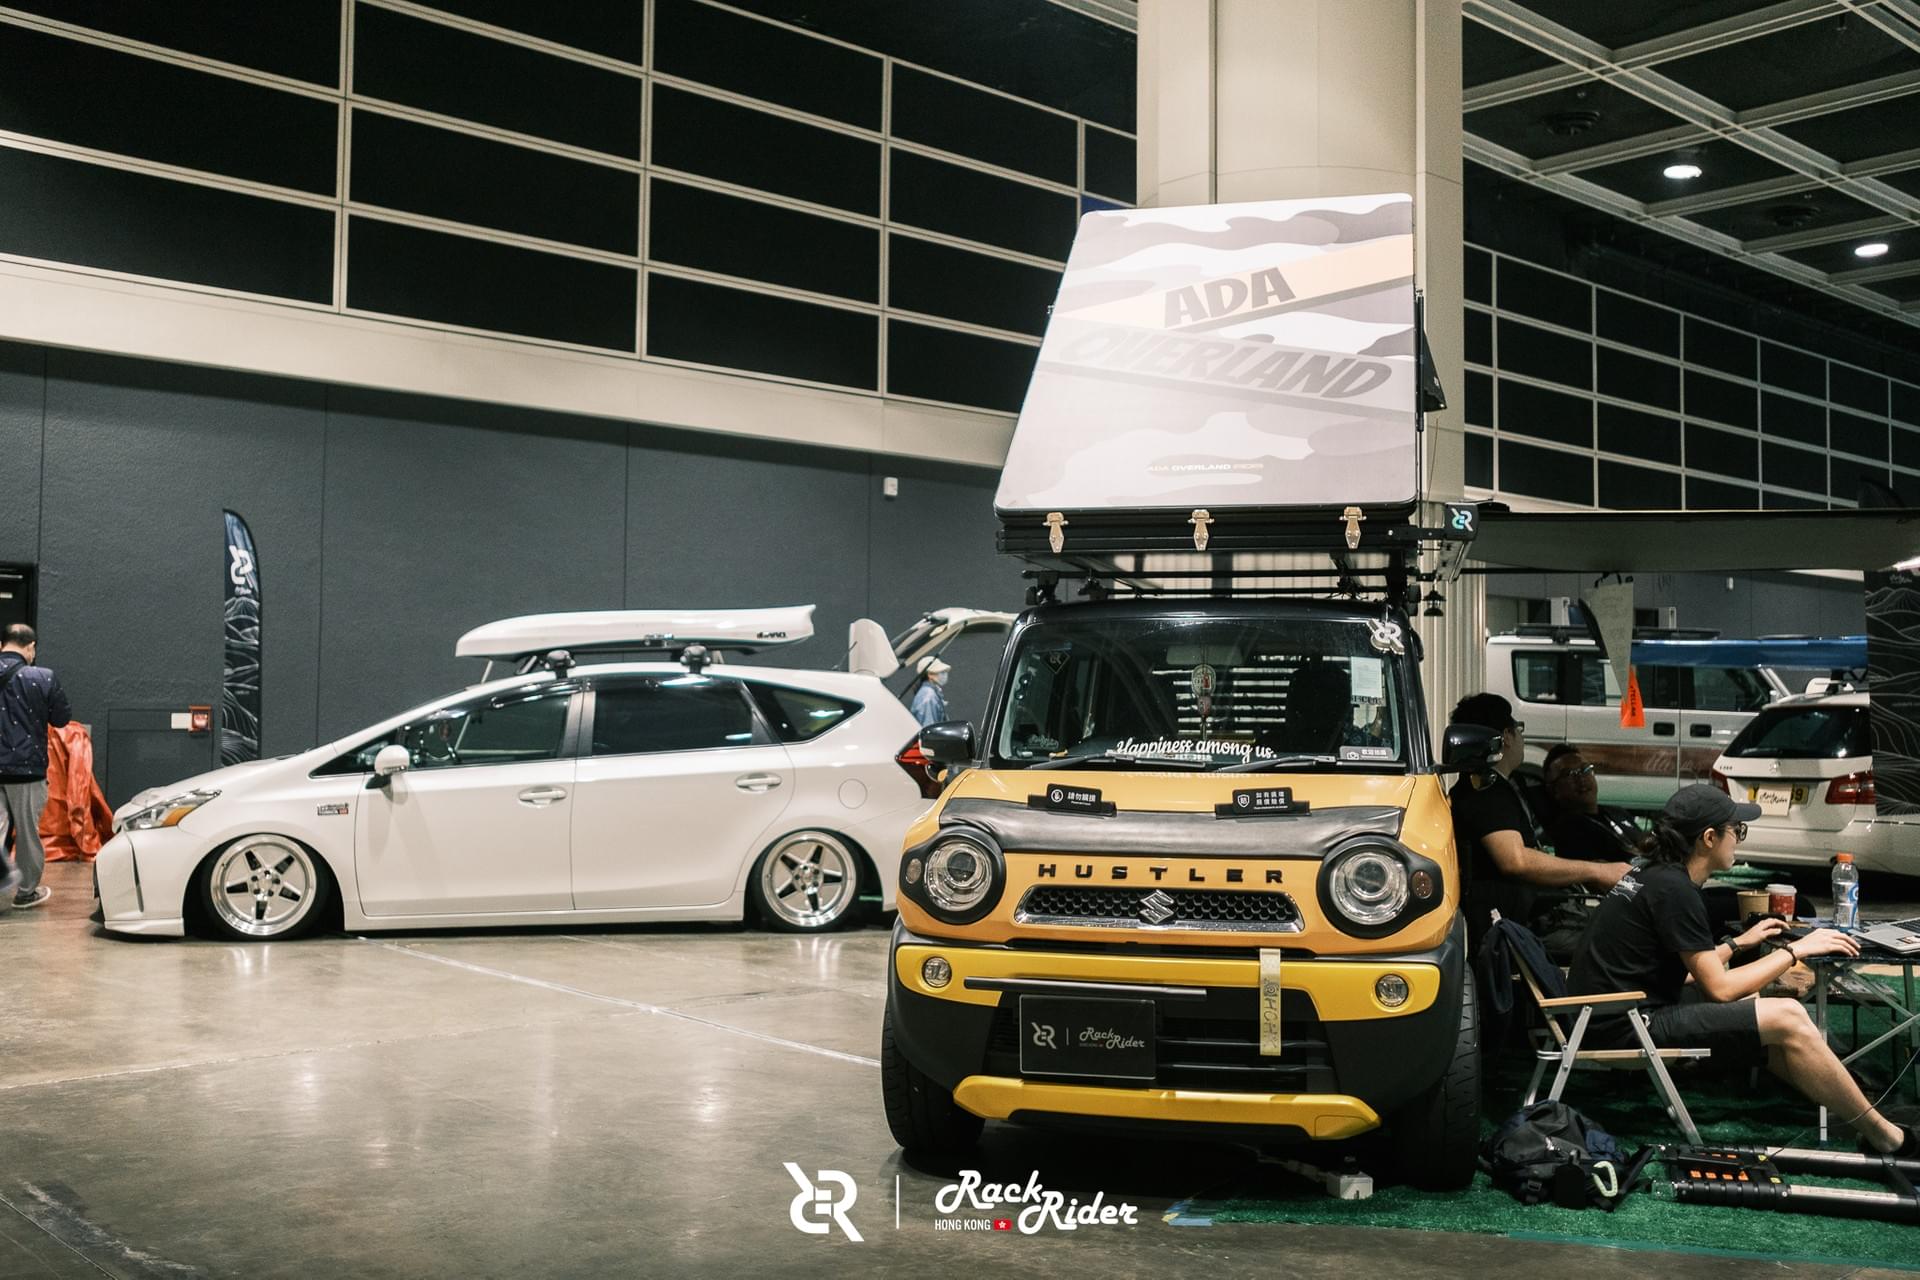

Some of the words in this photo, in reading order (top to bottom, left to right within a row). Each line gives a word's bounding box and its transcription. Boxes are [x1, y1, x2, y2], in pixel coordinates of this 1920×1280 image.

[1164, 266, 1297, 329] ADA
[1058, 327, 1393, 399] OVERLAND
[1116, 736, 1194, 758] Happiness
[1195, 740, 1254, 764] among
[1255, 745, 1279, 759] us.
[1037, 862, 1284, 884] HUSTLER
[1079, 1026, 1114, 1041] Rack
[1105, 1034, 1145, 1050] Rider
